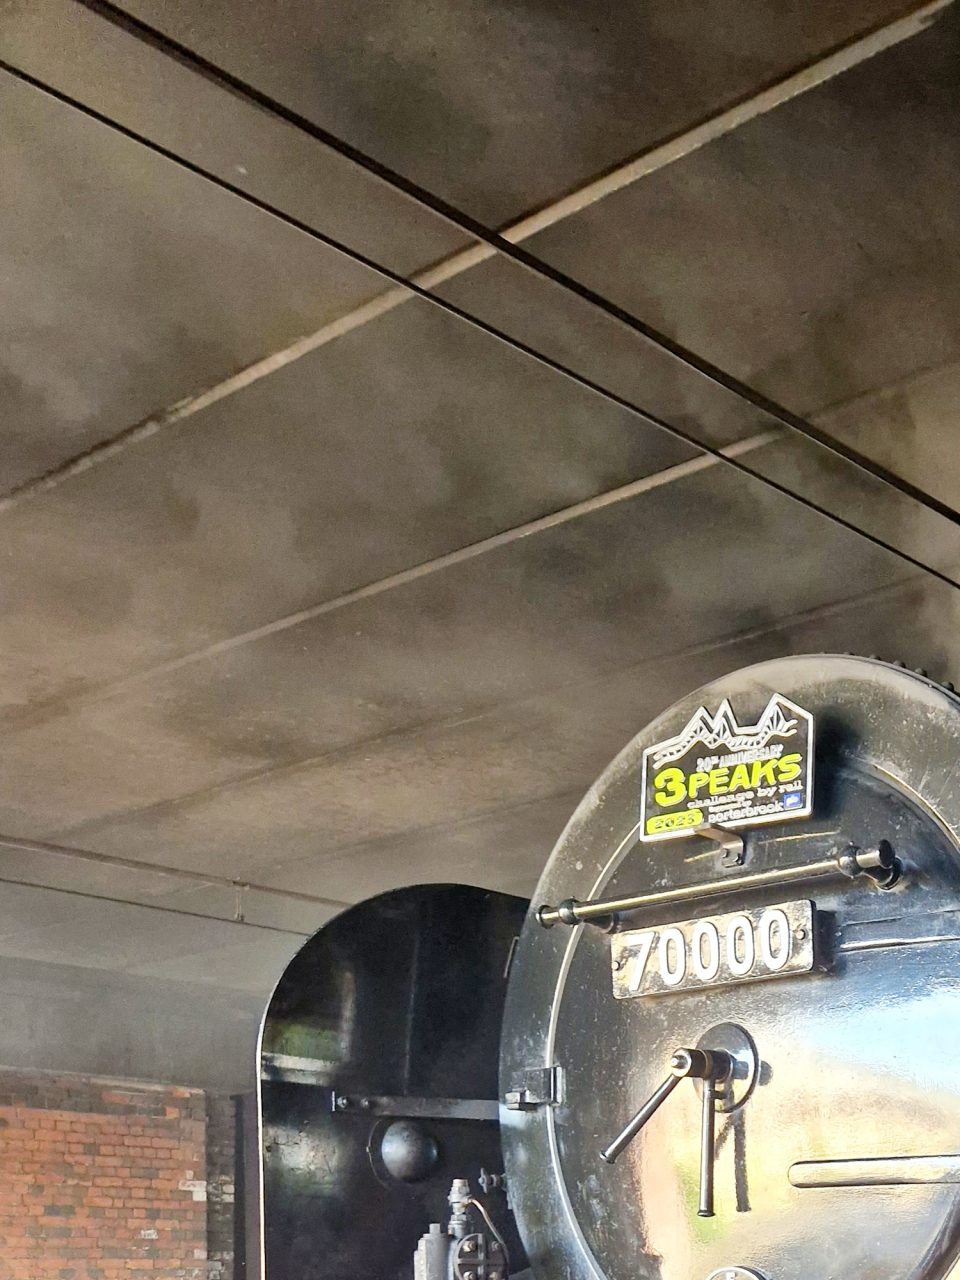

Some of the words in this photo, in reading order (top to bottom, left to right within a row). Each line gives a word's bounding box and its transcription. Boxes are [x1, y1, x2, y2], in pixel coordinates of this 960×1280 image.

[757, 785, 778, 799] by
[707, 800, 784, 824] porterbrook
[624, 909, 791, 991] 70000
